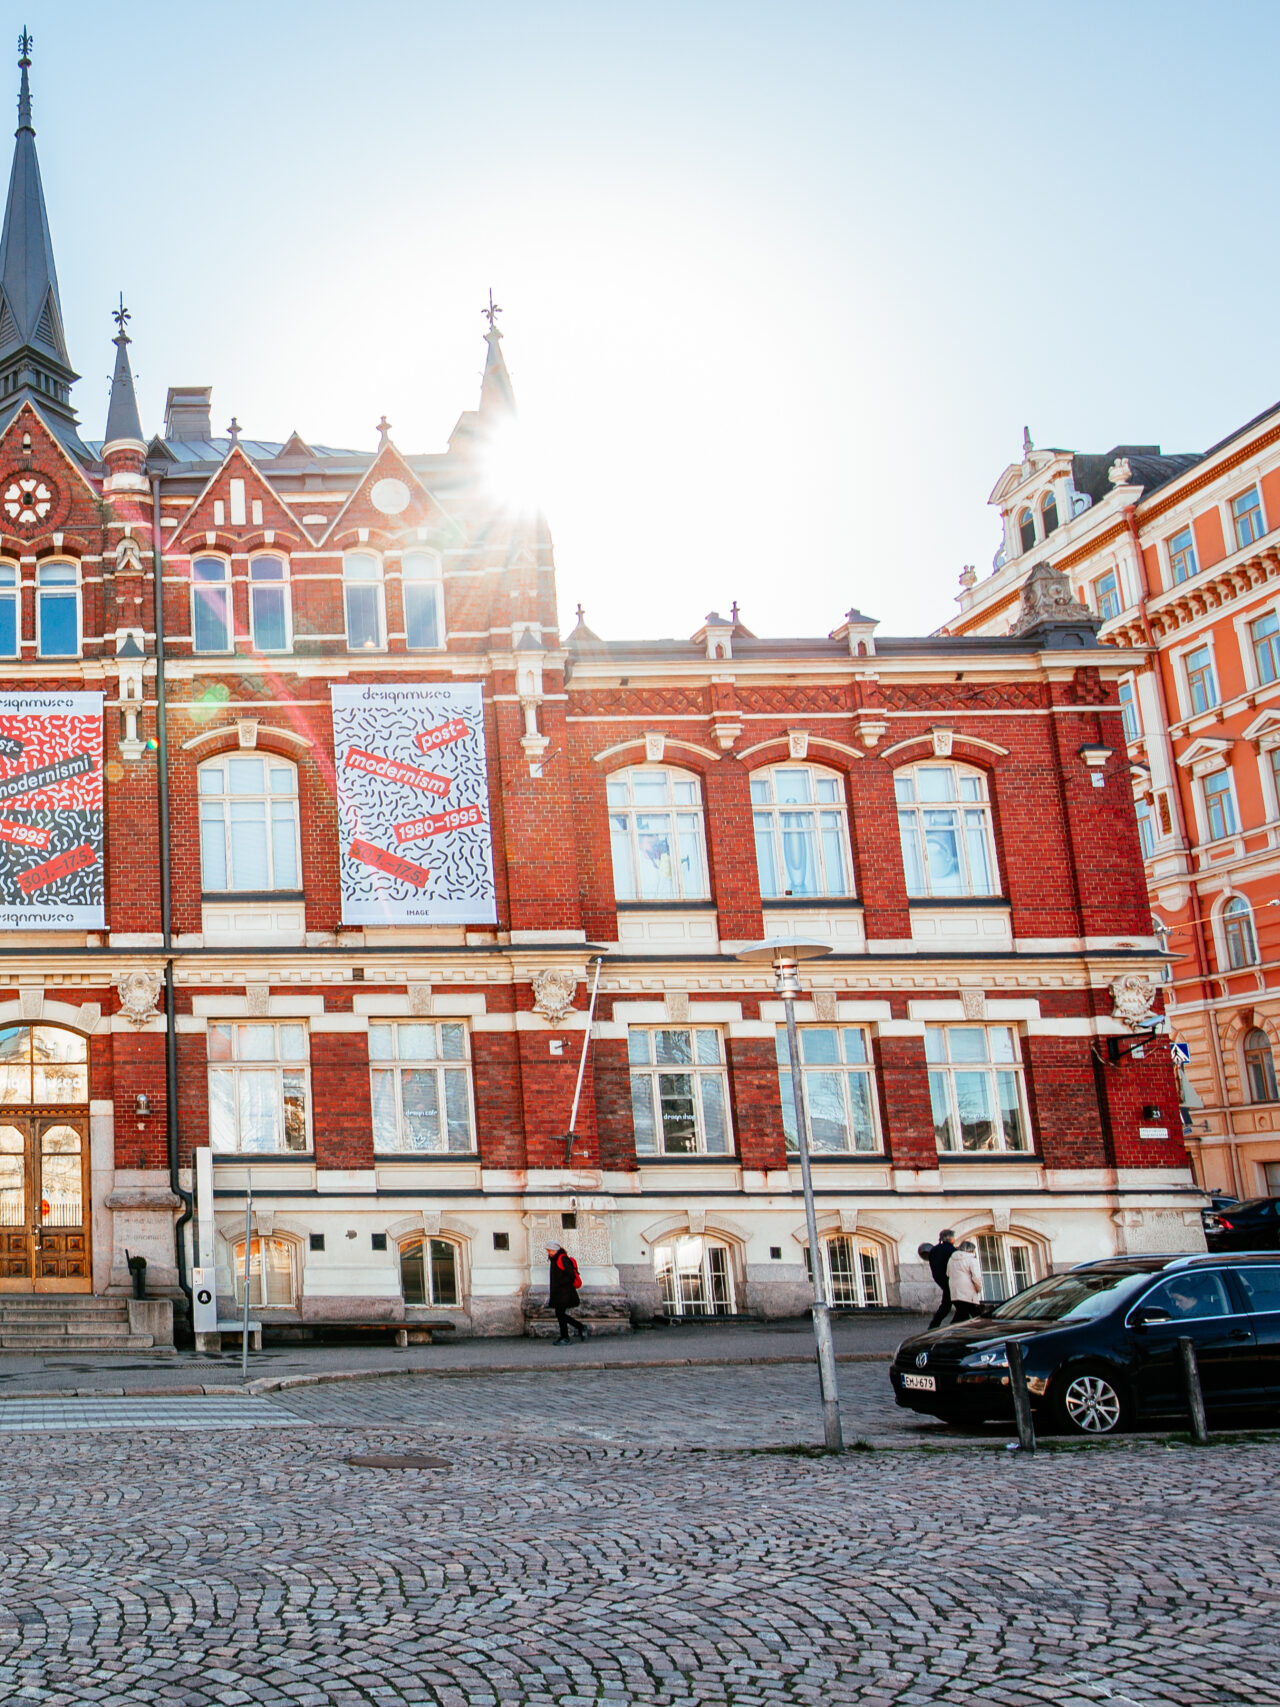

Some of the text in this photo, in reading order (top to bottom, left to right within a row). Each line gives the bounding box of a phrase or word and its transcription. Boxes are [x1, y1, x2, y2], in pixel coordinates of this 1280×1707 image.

[362, 687, 451, 704] designmuseo
[421, 723, 463, 751] post-
[348, 753, 446, 793] modernism
